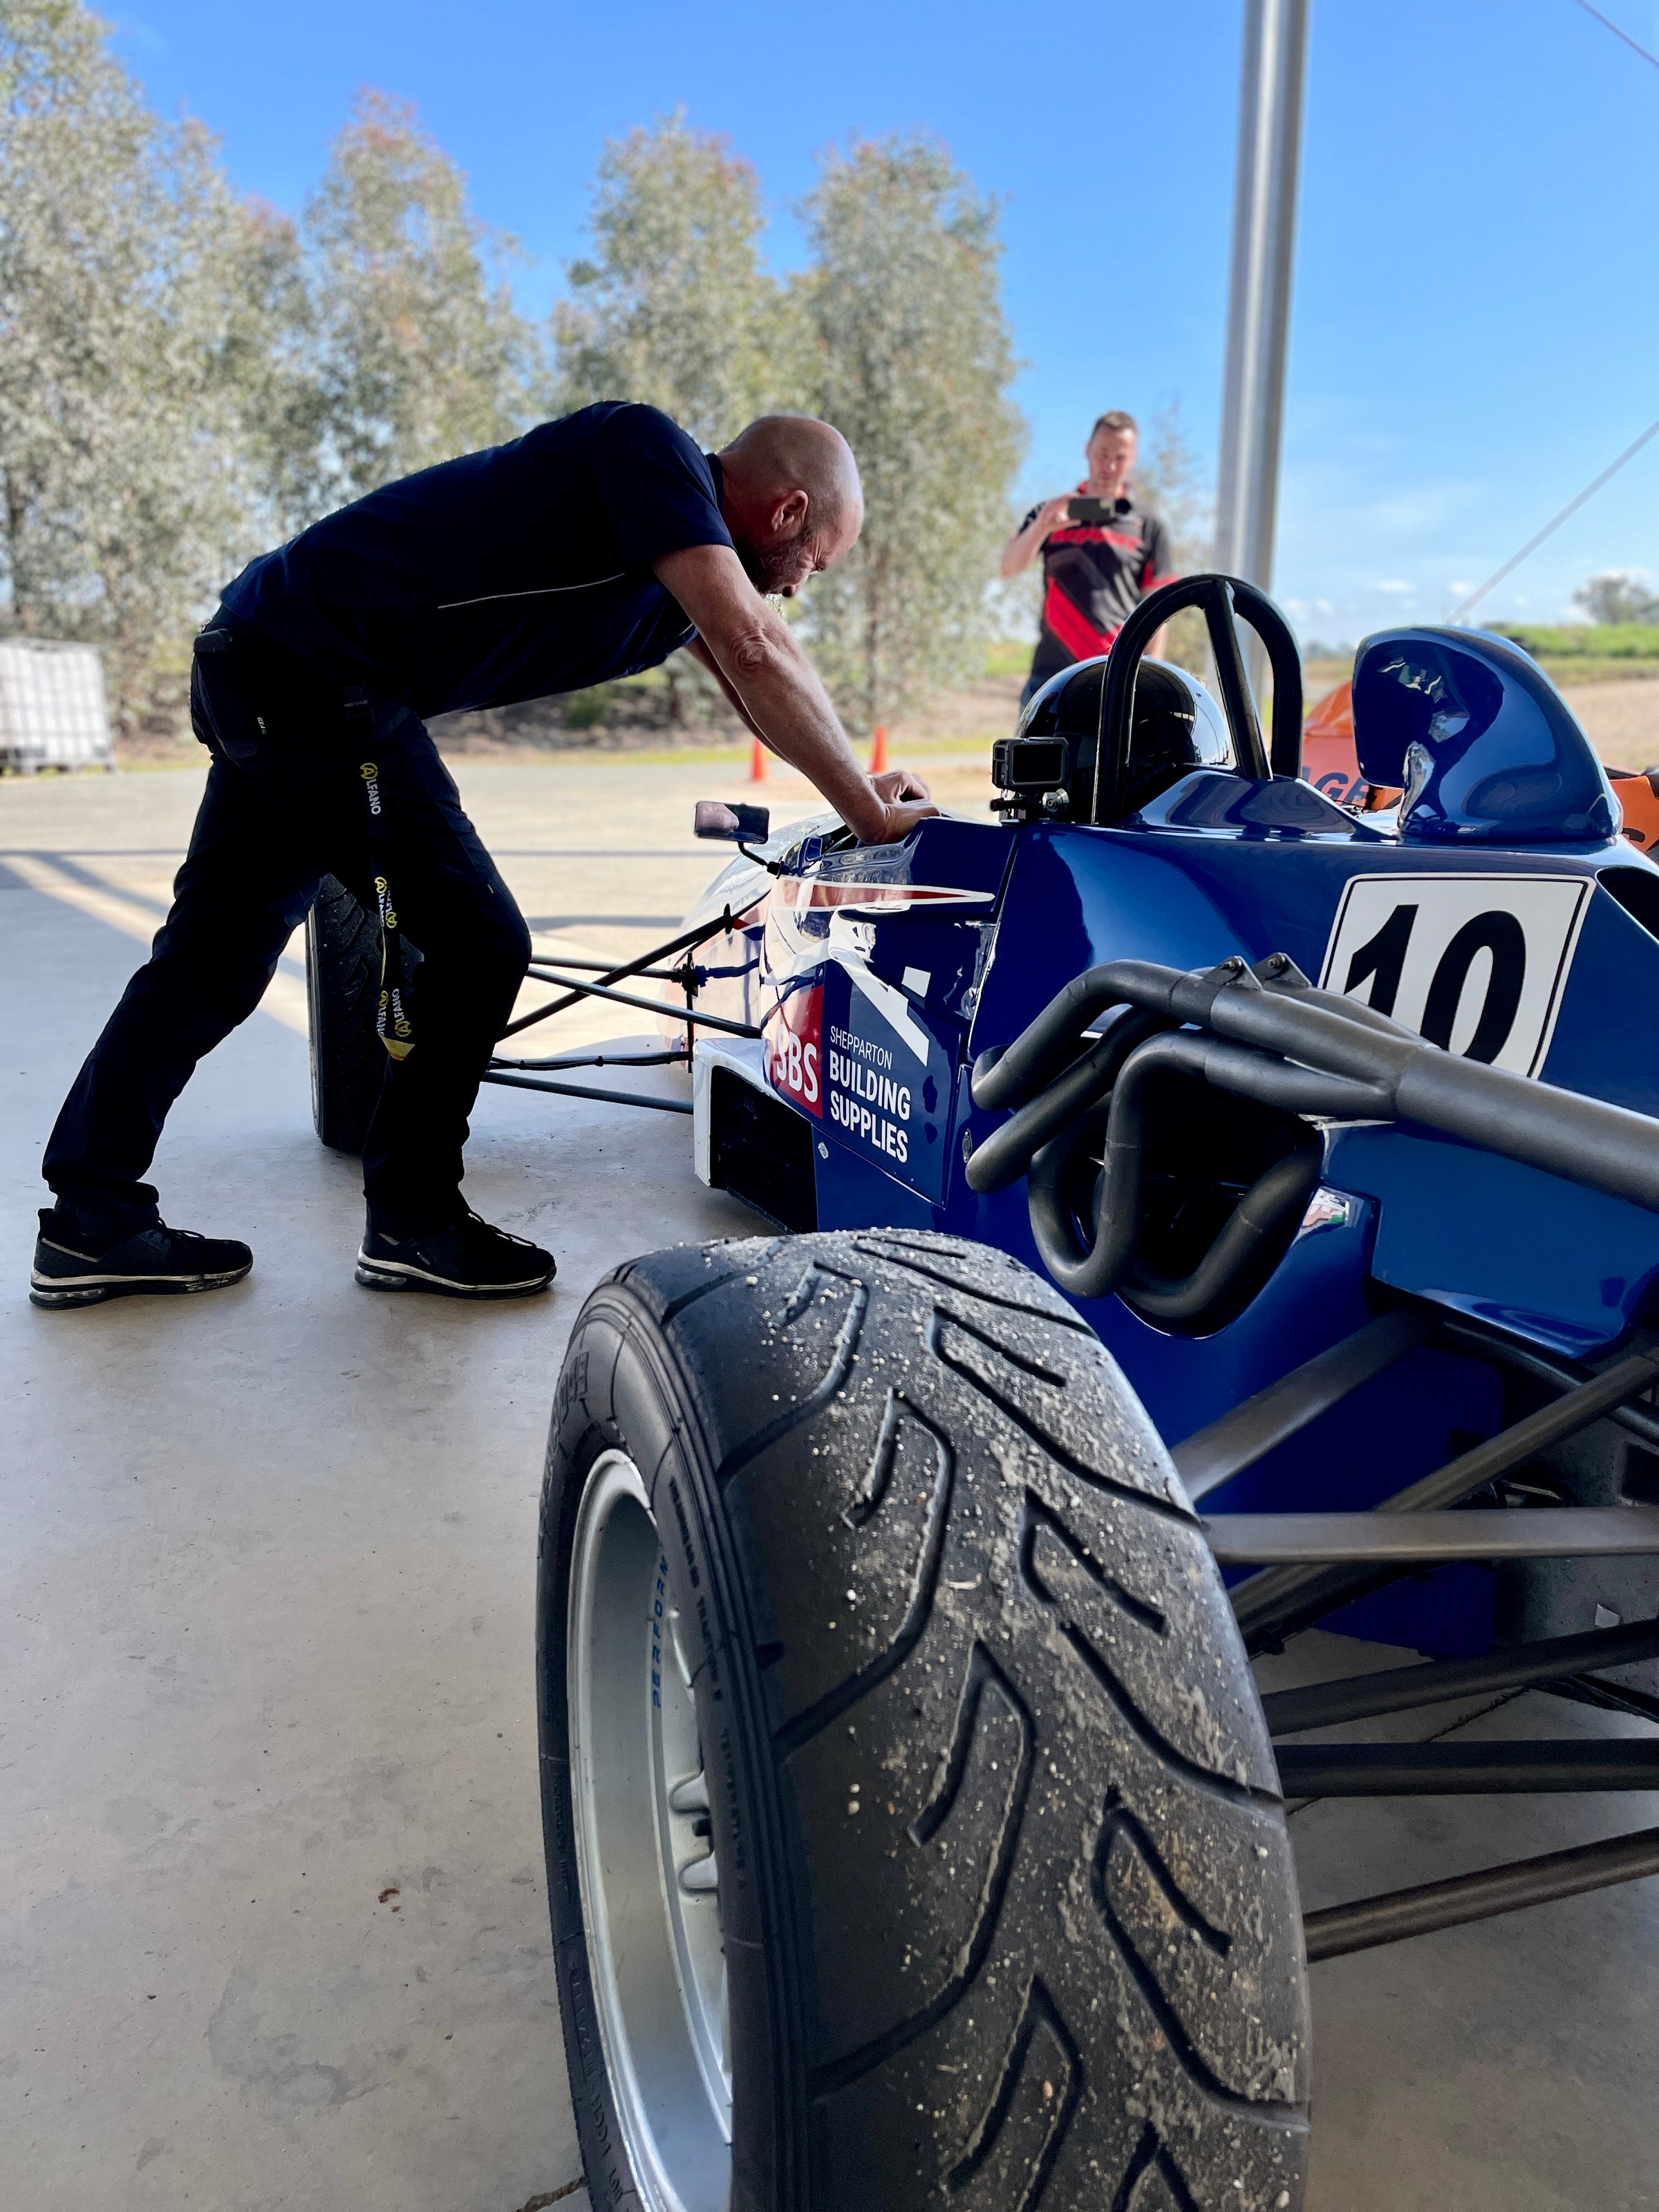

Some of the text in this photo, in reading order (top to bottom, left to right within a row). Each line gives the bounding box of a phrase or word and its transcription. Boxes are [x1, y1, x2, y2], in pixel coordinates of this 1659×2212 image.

[359, 762, 381, 814] ALFANO
[1343, 904, 1526, 1065] 10
[776, 1024, 818, 1103] SBS
[830, 1025, 892, 1070] SHEPPARTON
[830, 1049, 911, 1121] BUILDING
[830, 1090, 908, 1163] SUPPLIES
